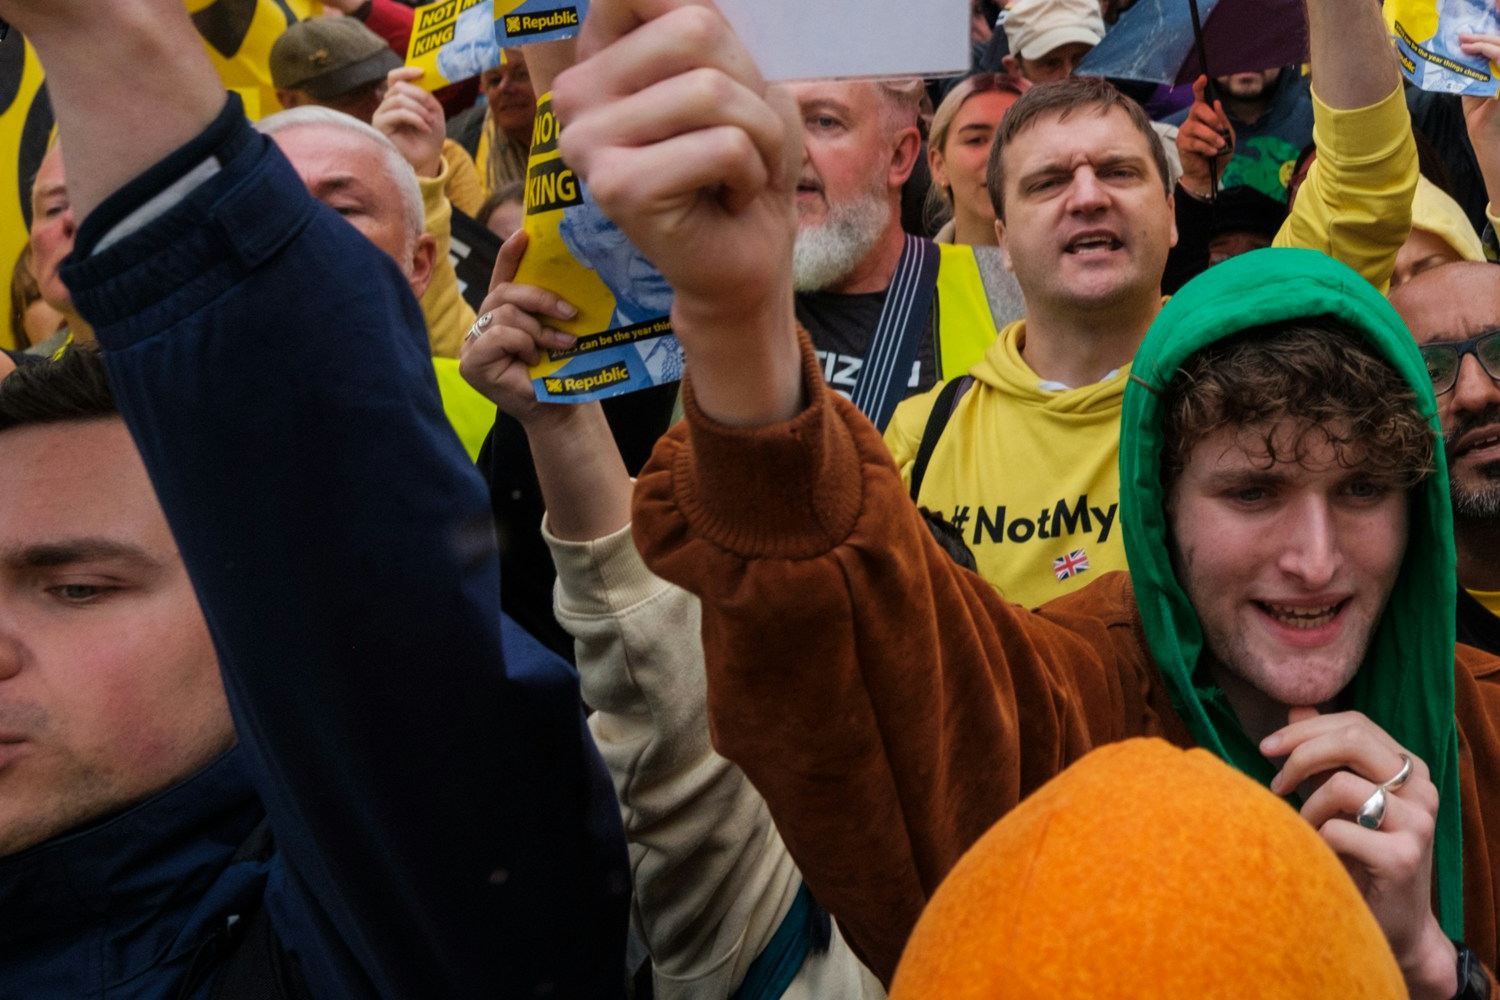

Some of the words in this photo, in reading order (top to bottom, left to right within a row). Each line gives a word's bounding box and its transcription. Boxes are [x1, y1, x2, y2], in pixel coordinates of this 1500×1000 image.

[422, 1, 456, 28] NOT
[522, 11, 577, 30] Republic
[415, 25, 454, 56] KING
[1418, 46, 1428, 59] the
[1428, 53, 1443, 66] year
[1443, 58, 1464, 74] things
[529, 169, 577, 209] KING
[580, 340, 598, 350] can
[599, 334, 613, 345] be
[614, 331, 631, 342] the
[632, 326, 652, 339] year
[565, 364, 628, 392] Republic
[951, 494, 1119, 545] #NotMy
